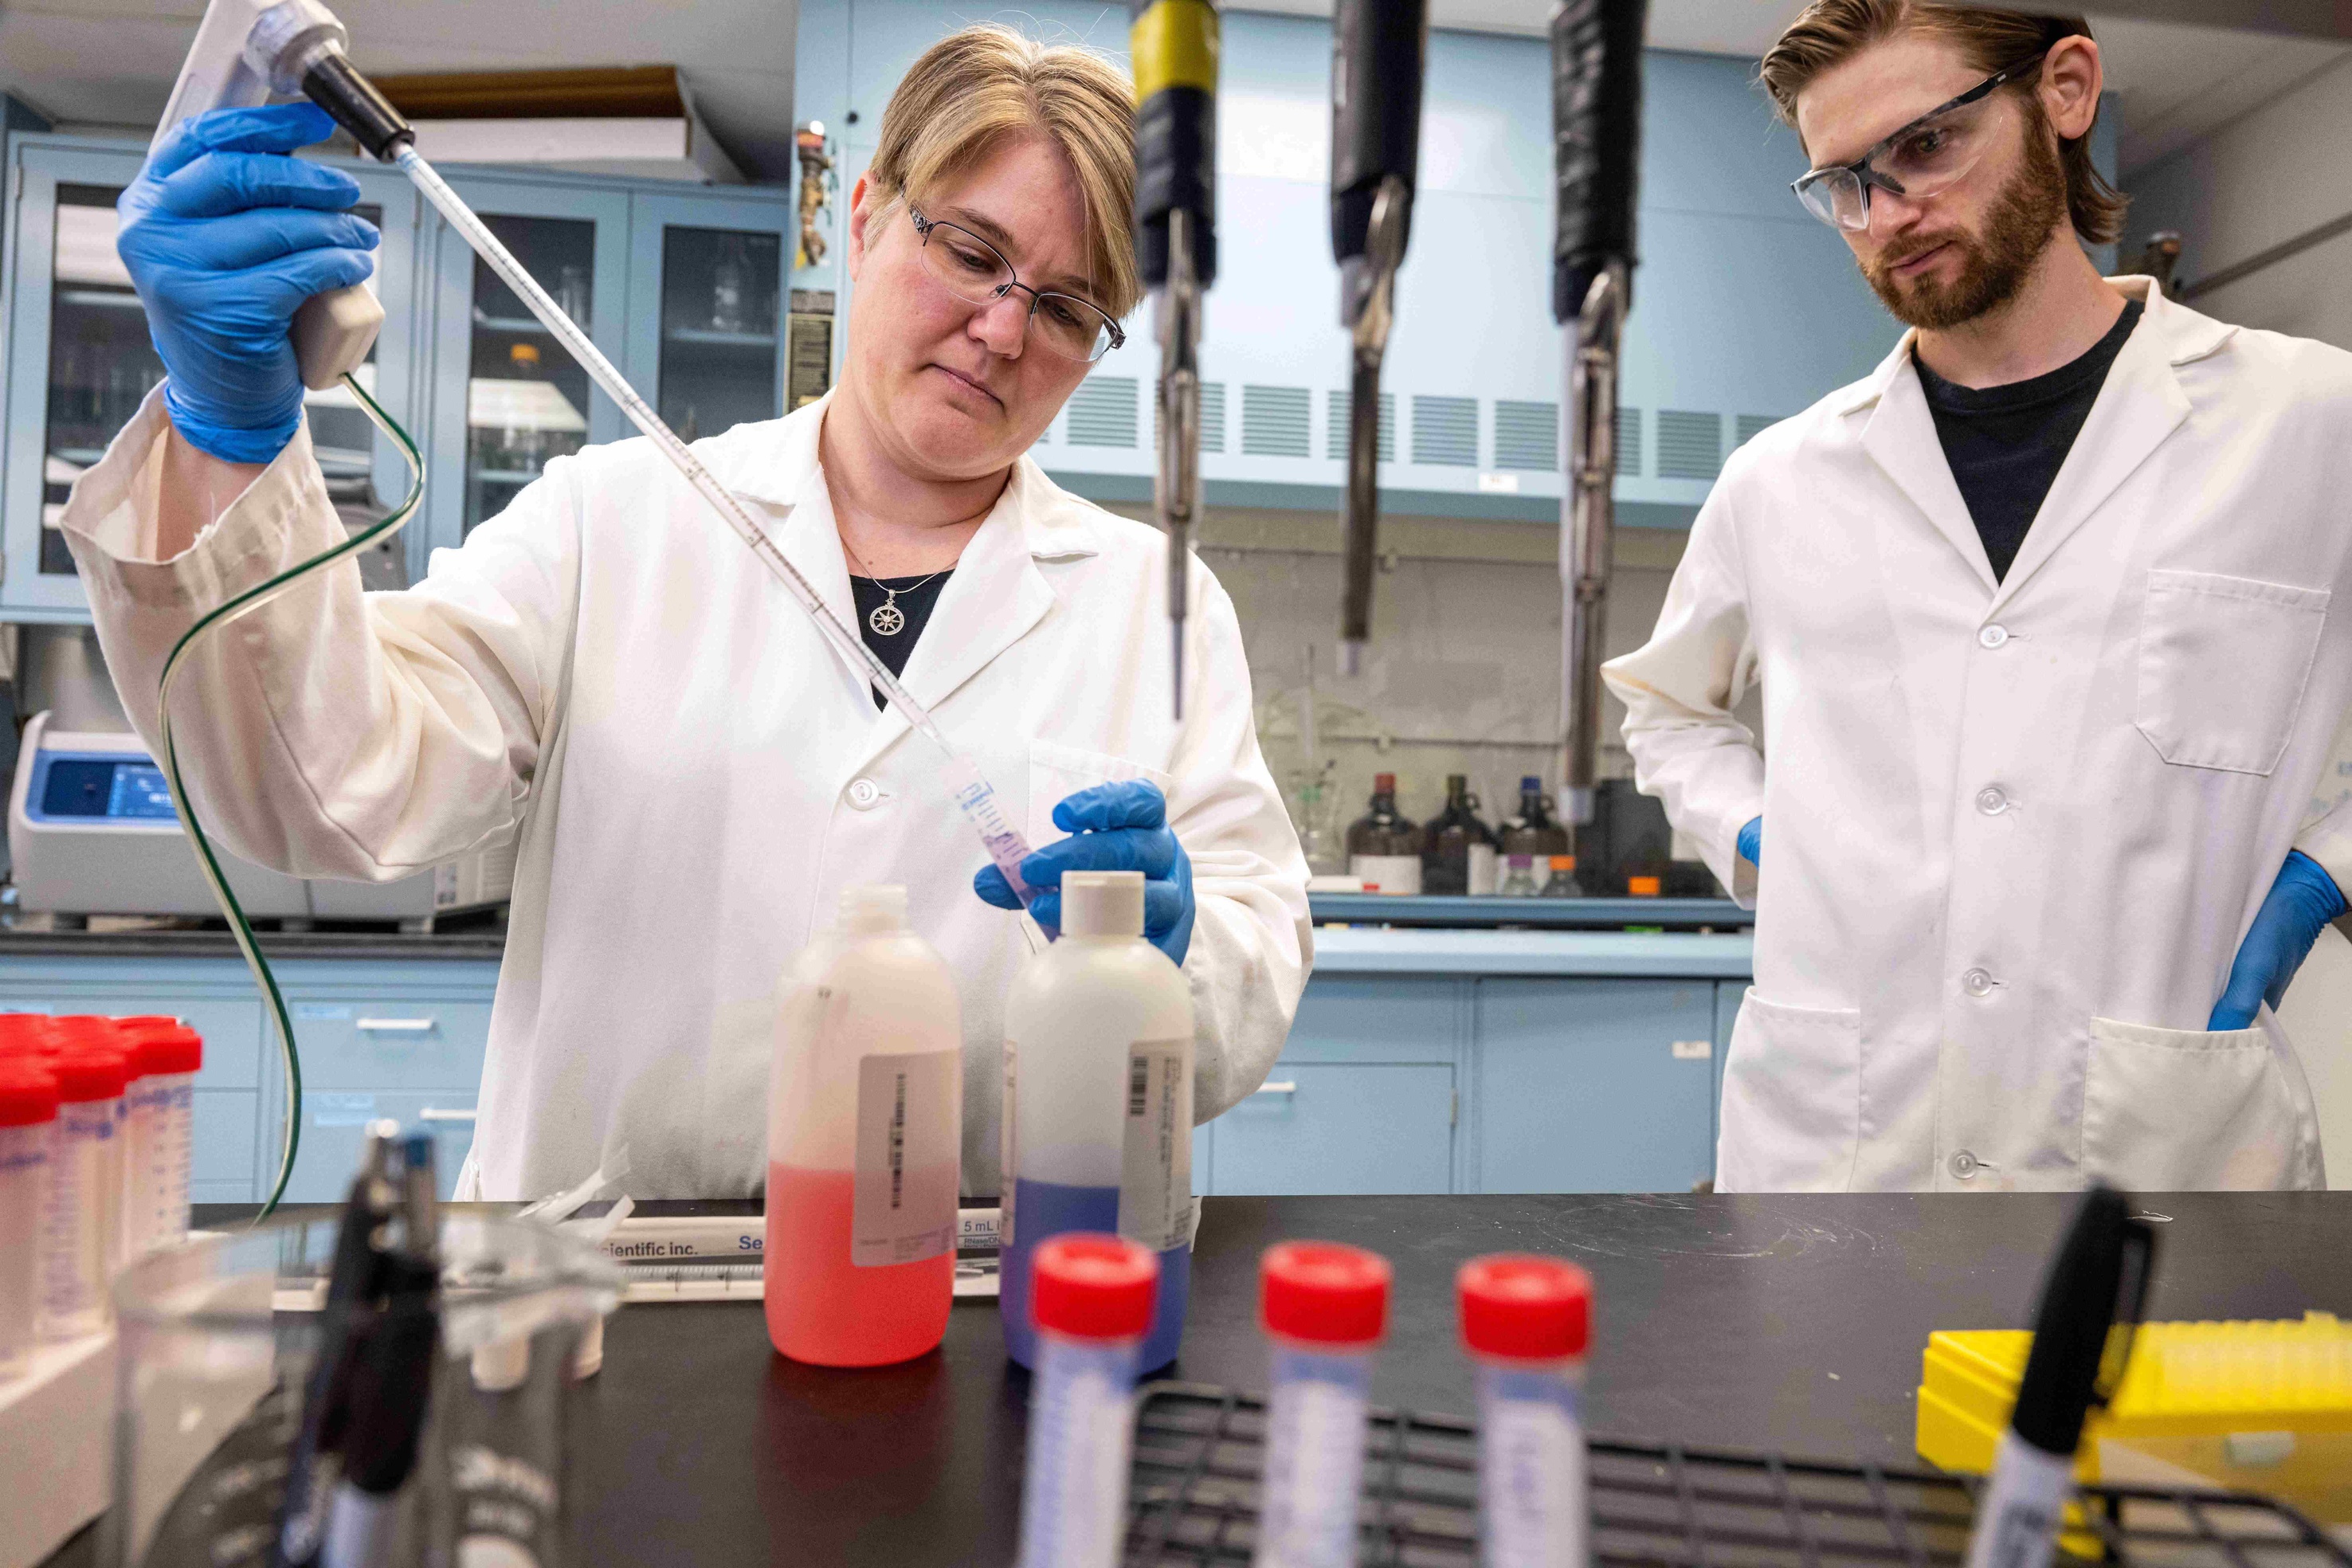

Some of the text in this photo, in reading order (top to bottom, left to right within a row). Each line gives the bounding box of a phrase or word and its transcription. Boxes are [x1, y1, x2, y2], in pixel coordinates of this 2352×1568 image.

[964, 1221, 971, 1232] 5
[975, 1220, 994, 1232] mL
[669, 1241, 698, 1256] inc.
[739, 1236, 763, 1250] Se
